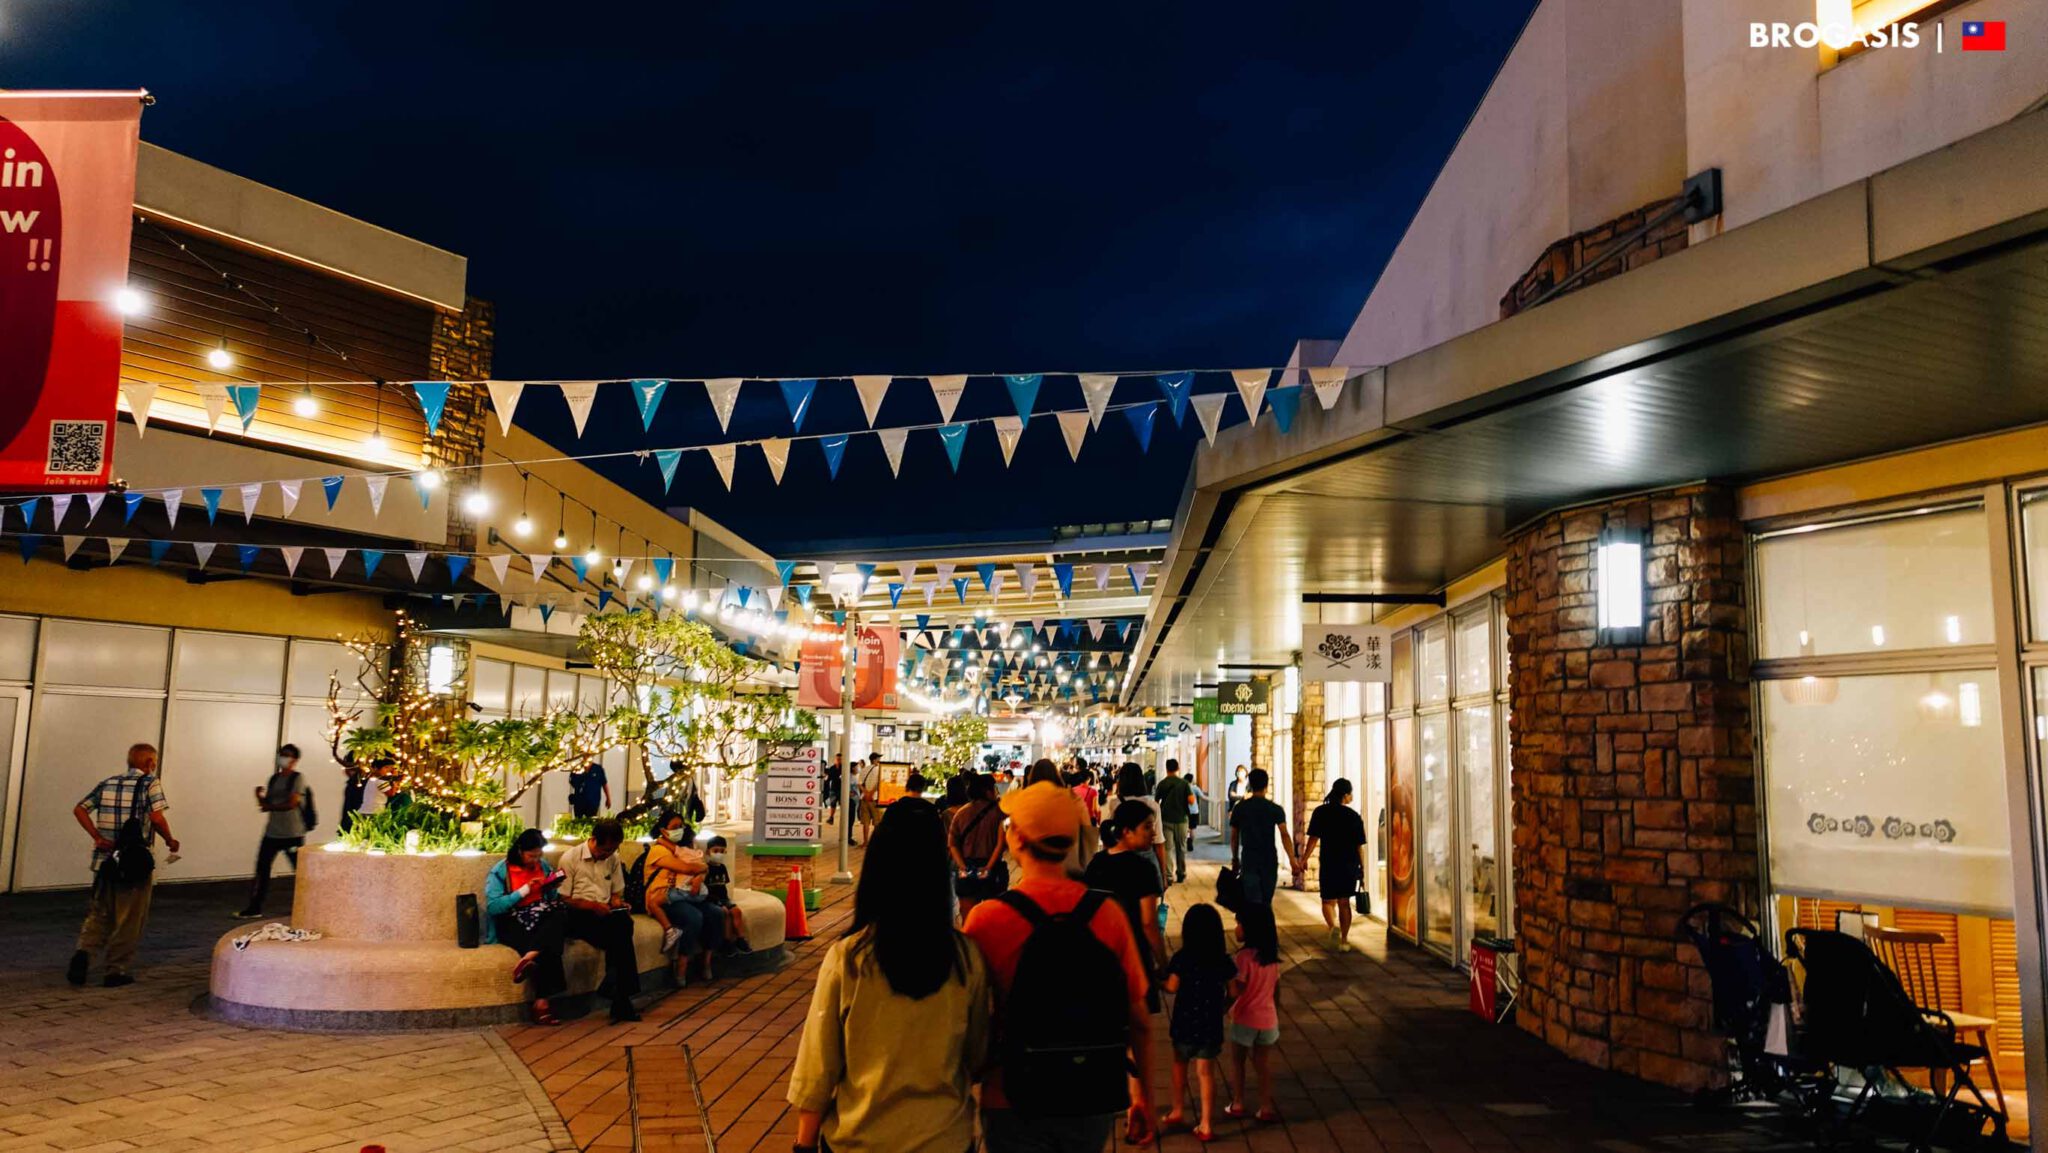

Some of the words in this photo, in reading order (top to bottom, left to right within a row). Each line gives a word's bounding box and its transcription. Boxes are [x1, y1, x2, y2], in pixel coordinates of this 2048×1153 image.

[858, 635, 881, 646] Join
[1220, 702, 1244, 714] roberto
[1244, 702, 1268, 714] cavalli
[775, 795, 798, 803] BOSS
[769, 826, 802, 837] TUMI
